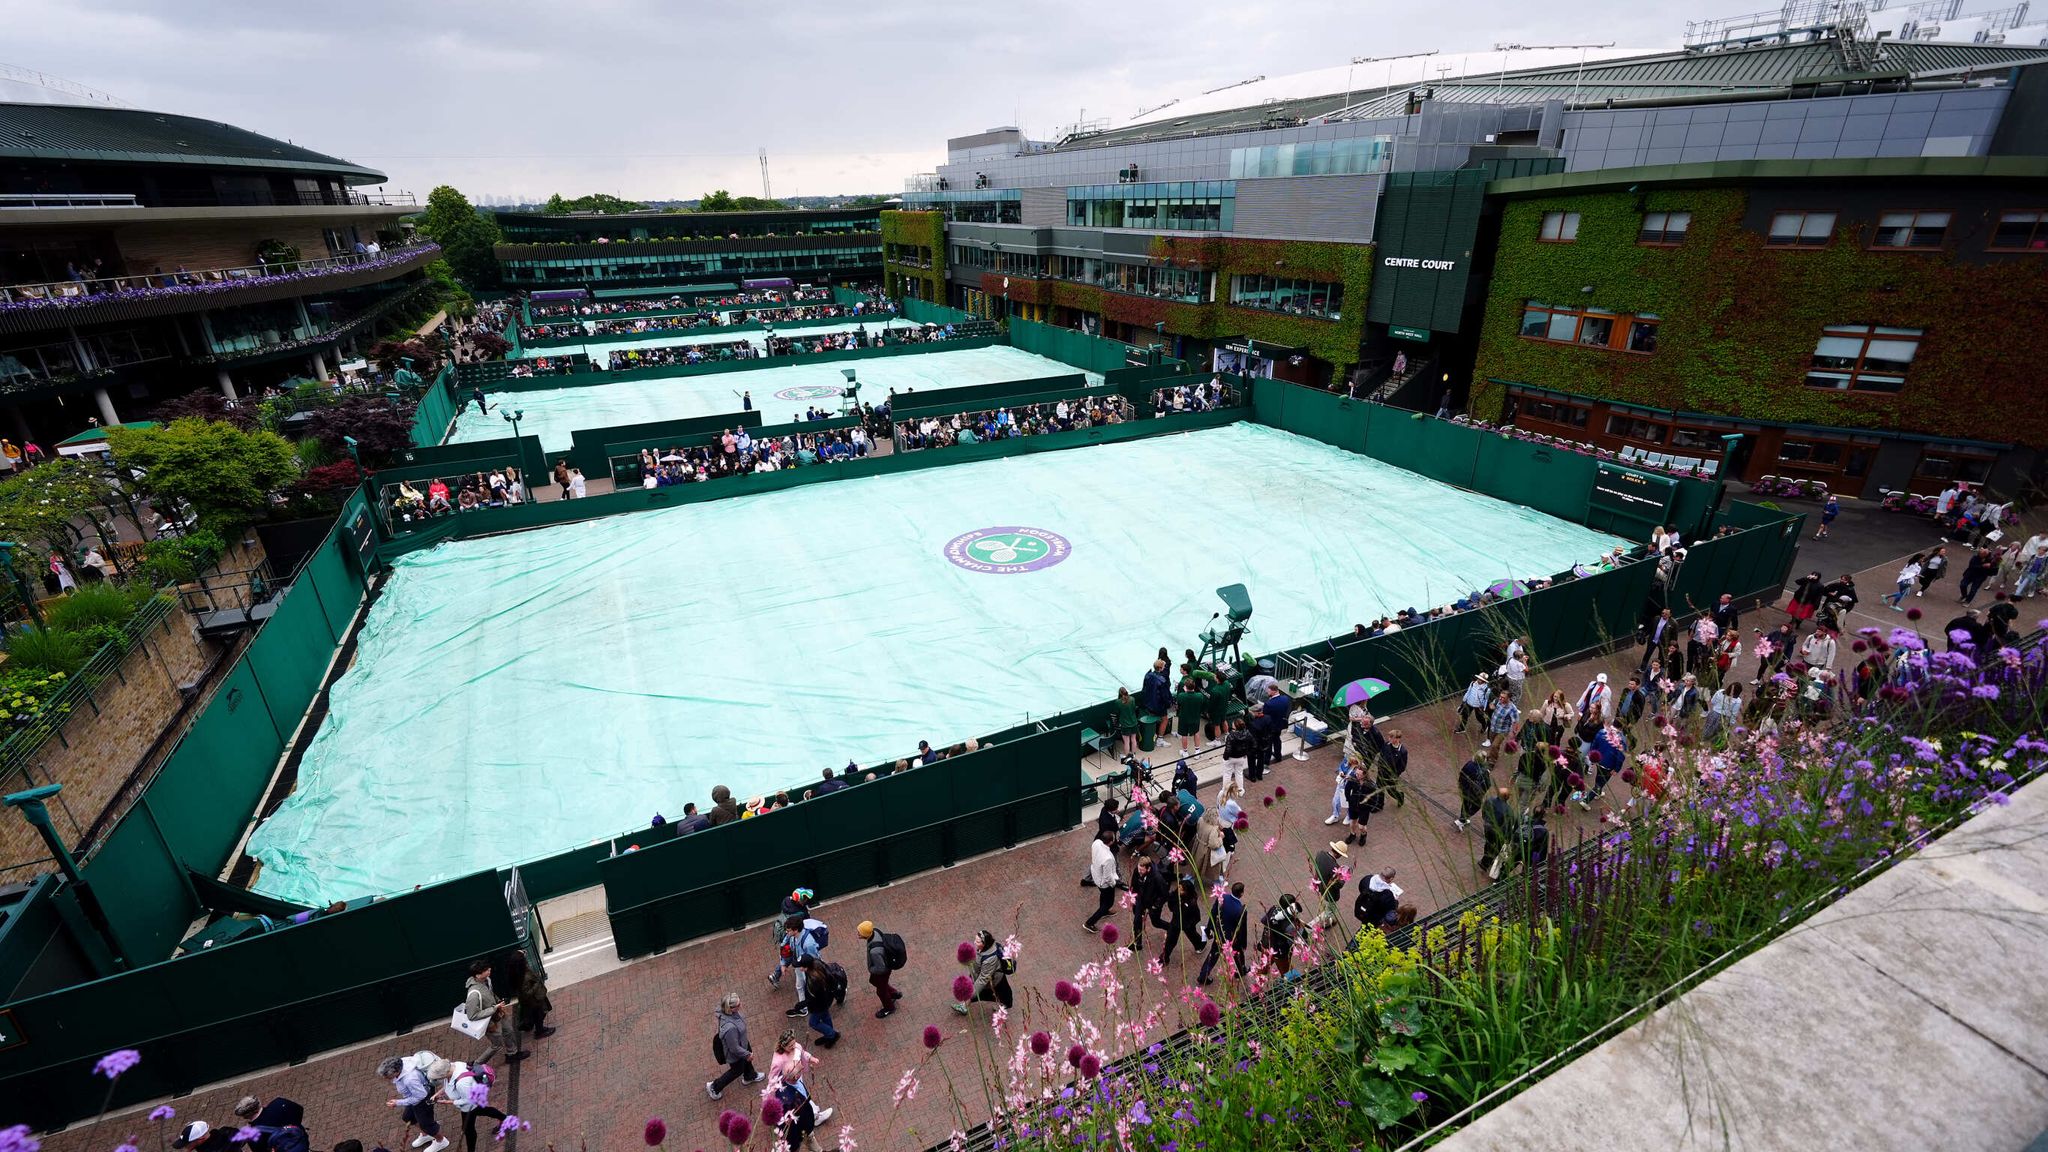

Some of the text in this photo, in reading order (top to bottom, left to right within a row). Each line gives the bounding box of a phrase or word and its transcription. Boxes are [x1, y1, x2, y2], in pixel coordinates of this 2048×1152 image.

[1384, 257, 1455, 271] CENTRE COURT
[1233, 346, 1260, 356] EXPERINCE
[404, 454, 414, 462] 15
[1018, 528, 1066, 557] WIMBLEDON
